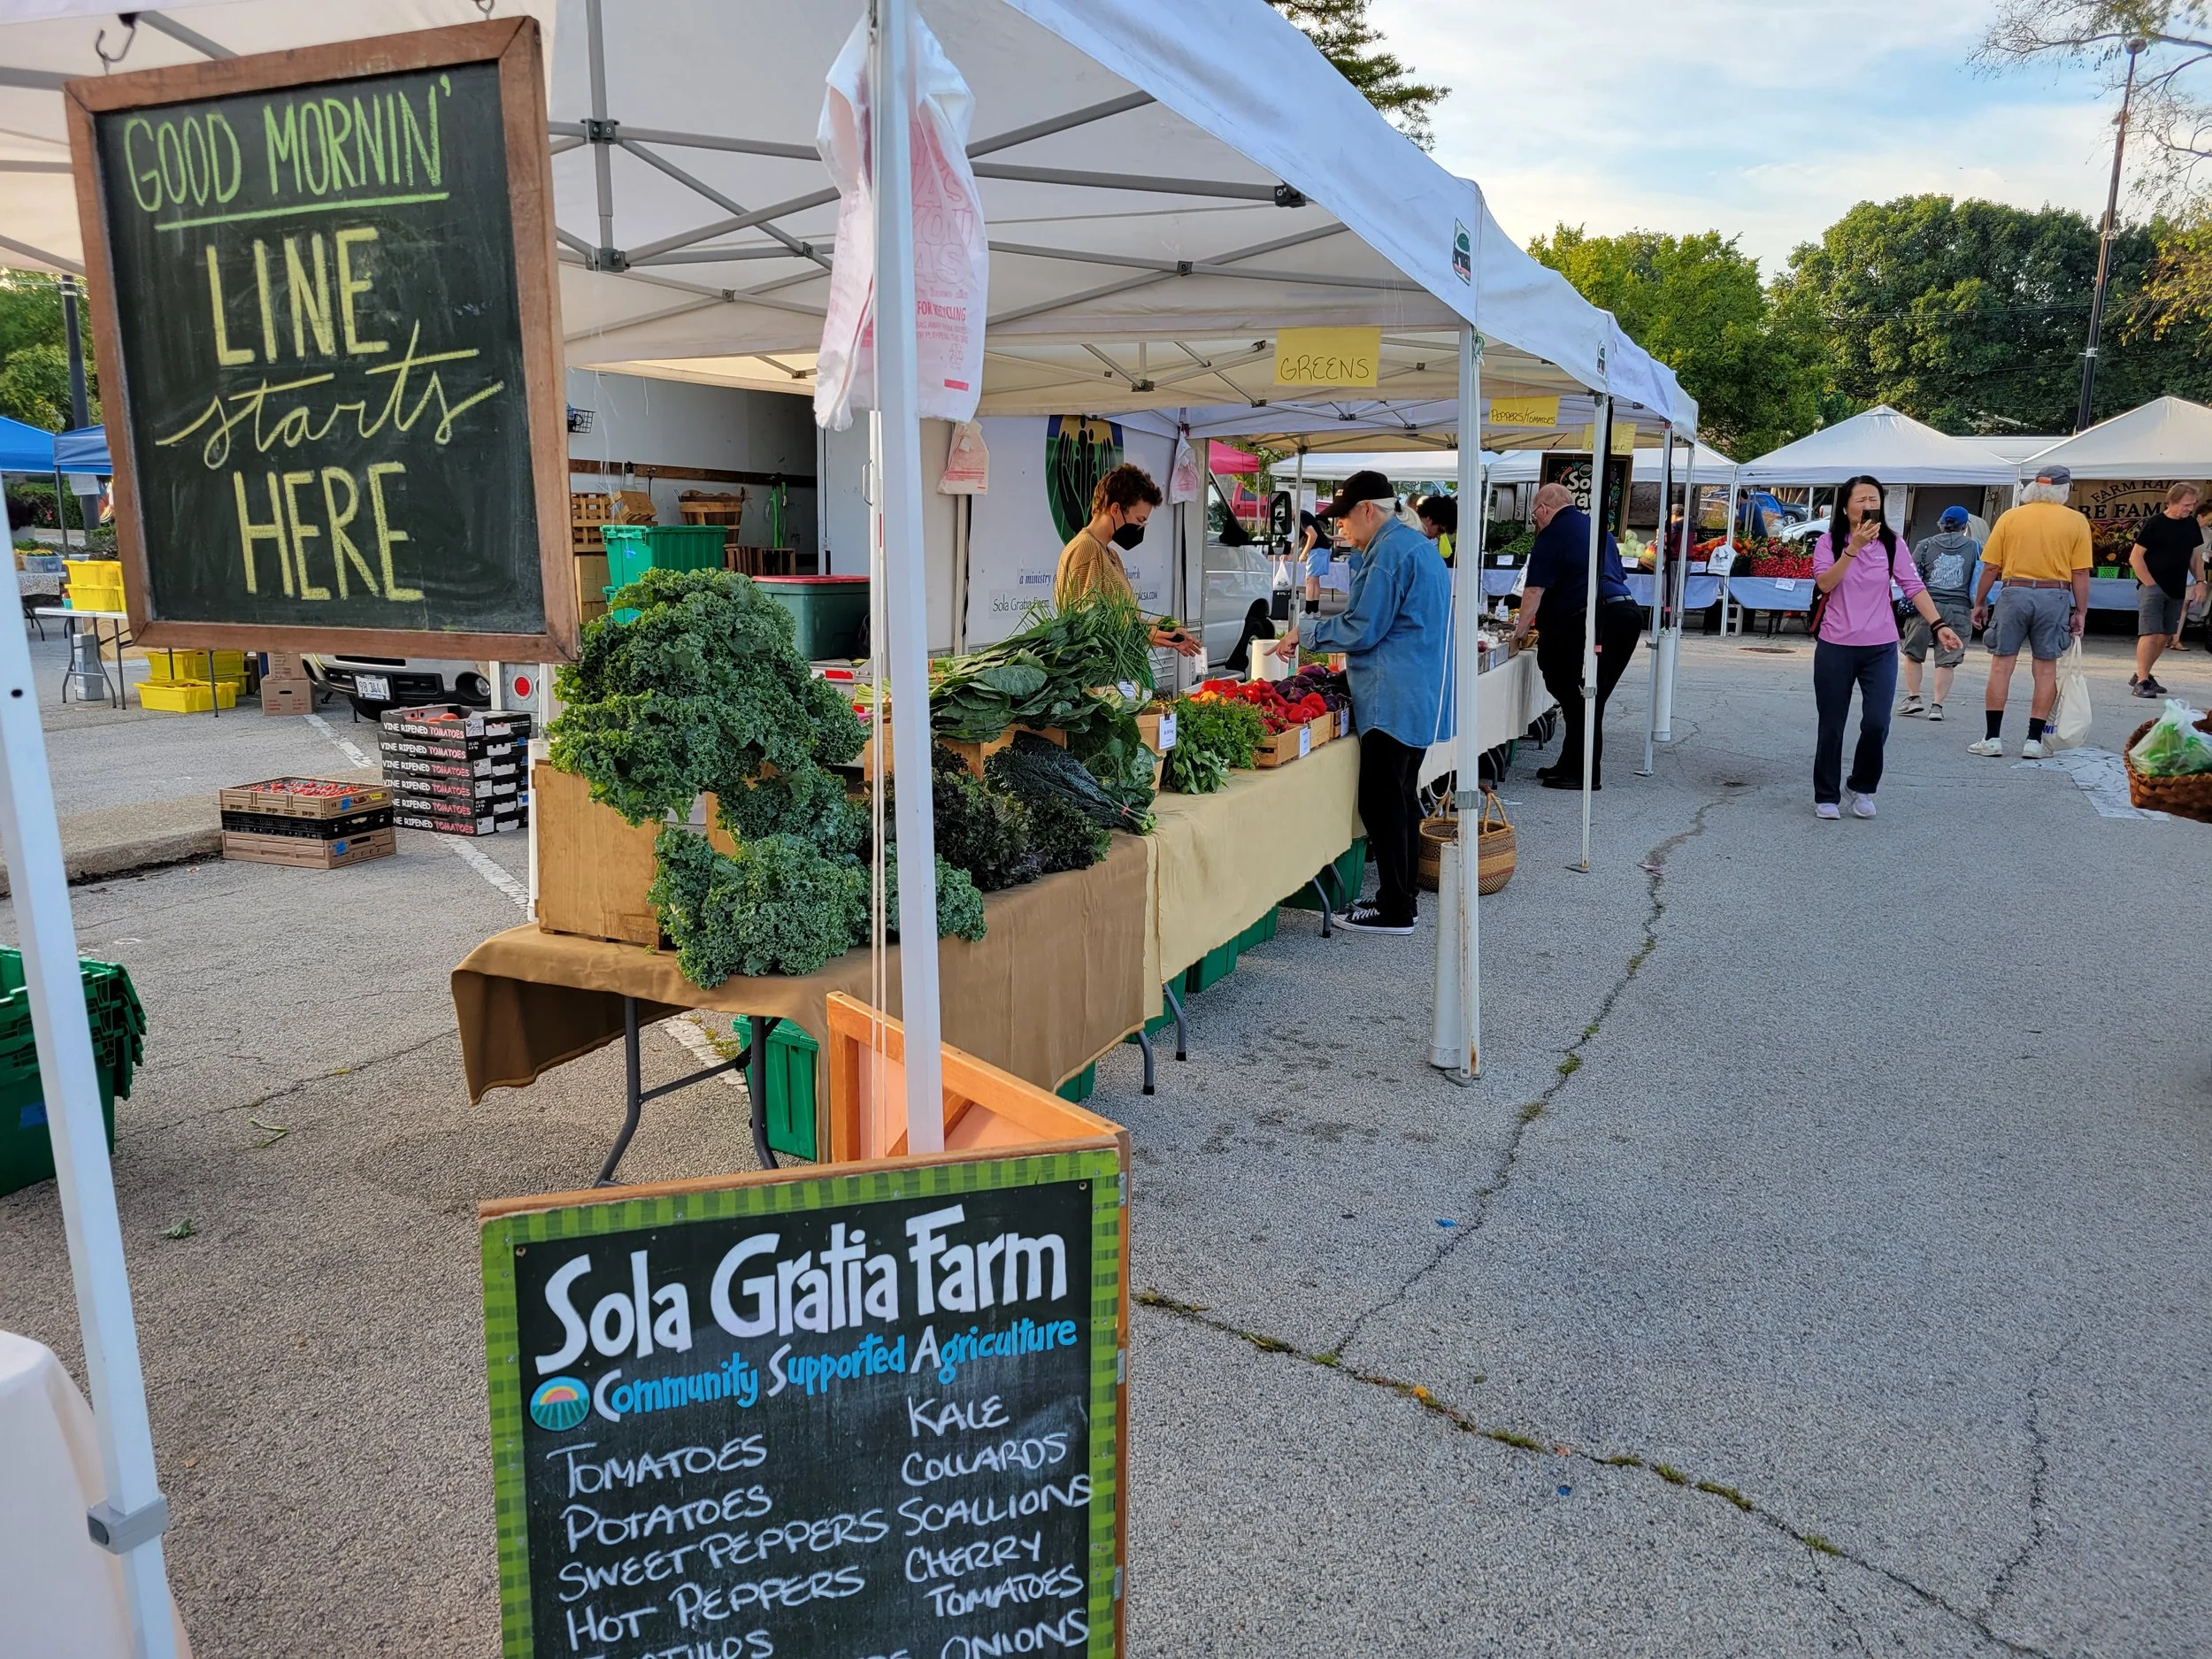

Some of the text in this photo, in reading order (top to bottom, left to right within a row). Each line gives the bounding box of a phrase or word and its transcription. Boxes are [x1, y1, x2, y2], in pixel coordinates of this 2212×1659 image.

[123, 73, 452, 213] GOOD MORNIN'
[206, 227, 389, 367] LINE
[917, 300, 933, 316] FOR
[1279, 354, 1370, 381] GREENS
[156, 318, 503, 469] starts
[1566, 471, 1591, 490] So
[2090, 480, 2137, 503] FARM
[233, 461, 426, 602] HERE
[2069, 502, 2166, 518] RE FAM
[993, 594, 1009, 612] Sola
[1010, 596, 1031, 611] Gratia
[1018, 575, 1024, 585] a
[1025, 571, 1051, 587] ministry
[380, 741, 466, 759] VINE RIPENED TOMATOES
[383, 722, 400, 732] VINE
[400, 724, 428, 734] RIPENED
[429, 726, 465, 739] TOMATOES
[382, 760, 400, 769] VINE
[401, 761, 430, 772] RIPENED
[431, 764, 470, 777] TOMATOES
[402, 780, 431, 791] RIPENED
[432, 783, 471, 796] TOMATOES
[402, 799, 431, 810] RIPENED
[432, 803, 472, 815] TOMATOES
[403, 818, 434, 828] RIPENED
[434, 820, 474, 833] TOMATOES
[536, 1203, 1068, 1376] Sola Gratia Farm
[593, 1313, 1078, 1423] Community Supported Agriculture
[908, 1394, 1010, 1438] KALE
[546, 1433, 768, 1499] TOMATOES
[901, 1432, 1068, 1487] COLLARDS
[560, 1484, 773, 1553] POTATOES
[896, 1474, 1094, 1537] SCALLIONS
[558, 1508, 890, 1602] SWEET PEPPERS
[904, 1530, 1041, 1583] CHERRY
[565, 1563, 866, 1651] HOT PEPPERS
[923, 1563, 1085, 1617] TOMATOES
[941, 1608, 1090, 1659] ONIONS
